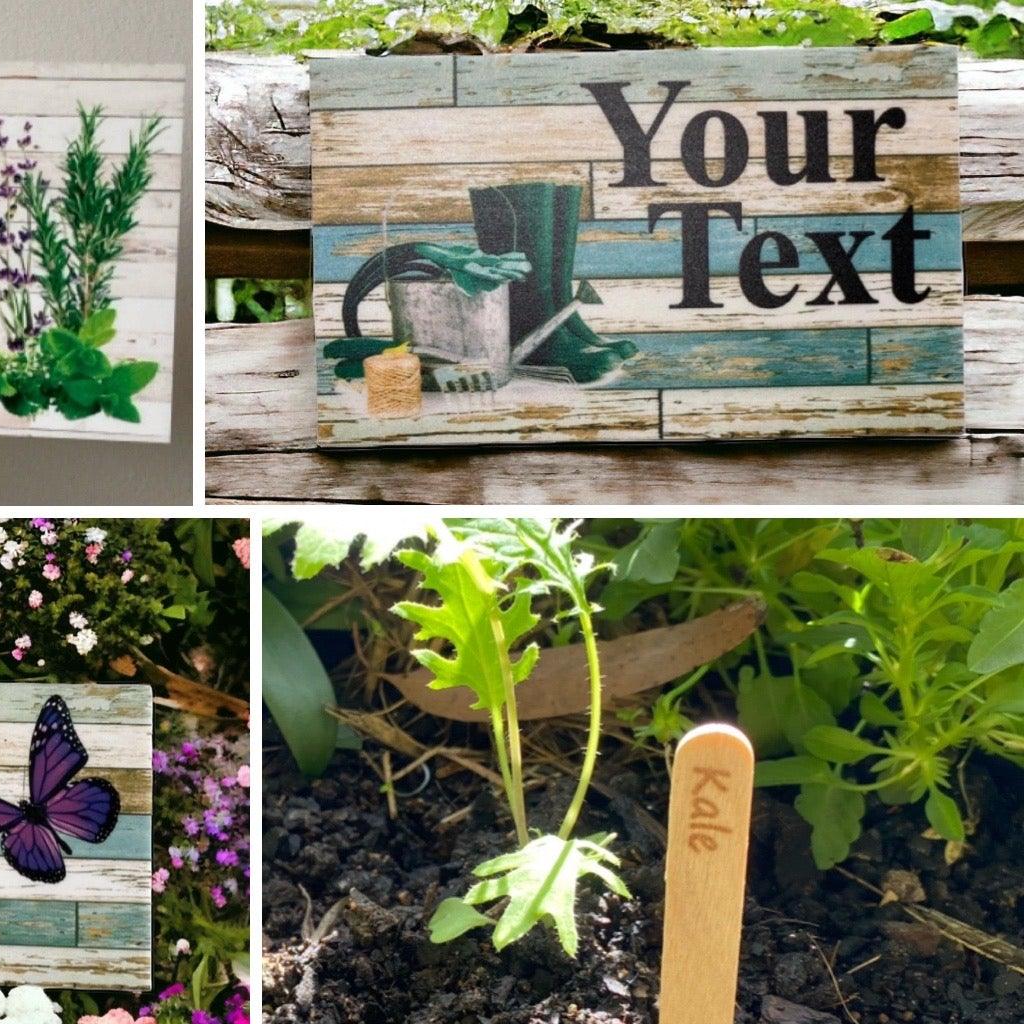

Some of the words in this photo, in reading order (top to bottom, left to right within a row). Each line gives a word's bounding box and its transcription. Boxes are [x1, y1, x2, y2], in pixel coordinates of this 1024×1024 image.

[580, 80, 907, 188] Your
[647, 202, 932, 310] Text
[688, 767, 732, 854] Kale
